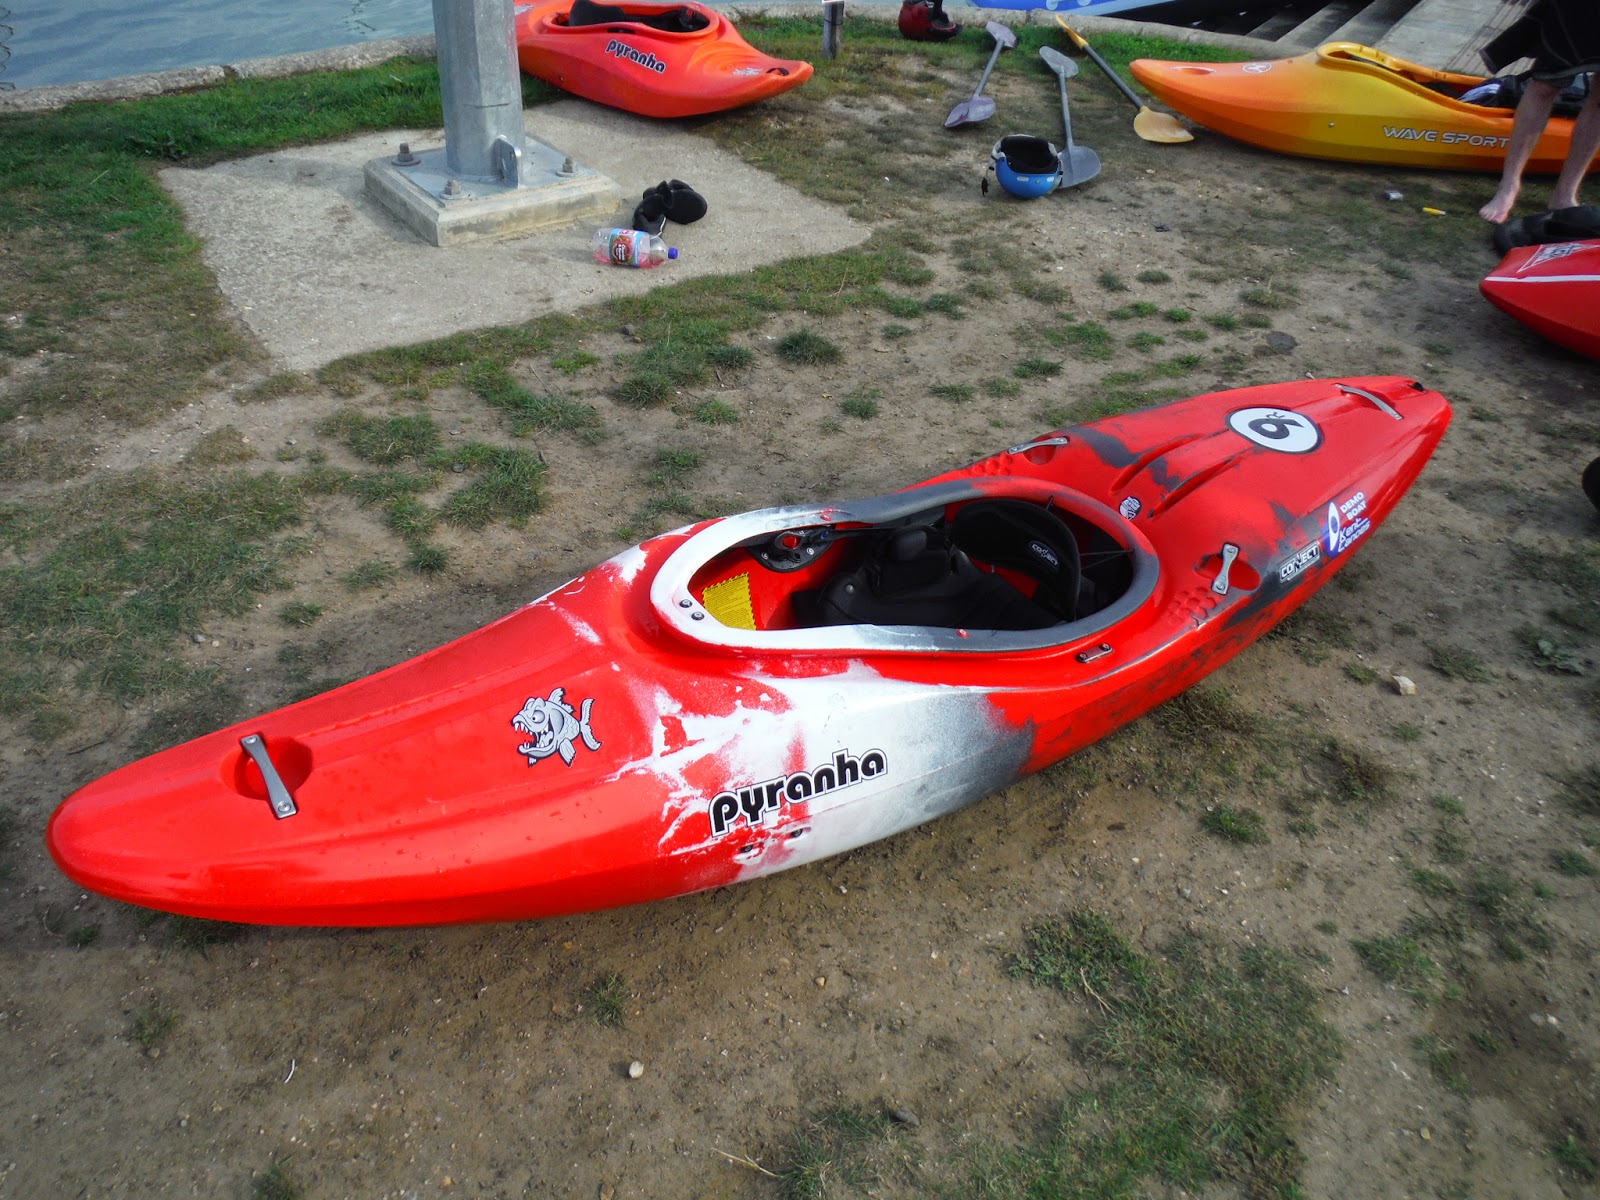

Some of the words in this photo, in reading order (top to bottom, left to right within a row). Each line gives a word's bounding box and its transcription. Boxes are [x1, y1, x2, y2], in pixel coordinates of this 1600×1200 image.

[606, 39, 666, 74] pyranha
[1383, 126, 1438, 142] WAVE
[1441, 132, 1512, 148] SPORT
[1339, 491, 1364, 514] DEMO
[1345, 500, 1367, 521] BOAT
[1339, 517, 1369, 542] Kent
[711, 749, 886, 836] pyranha
